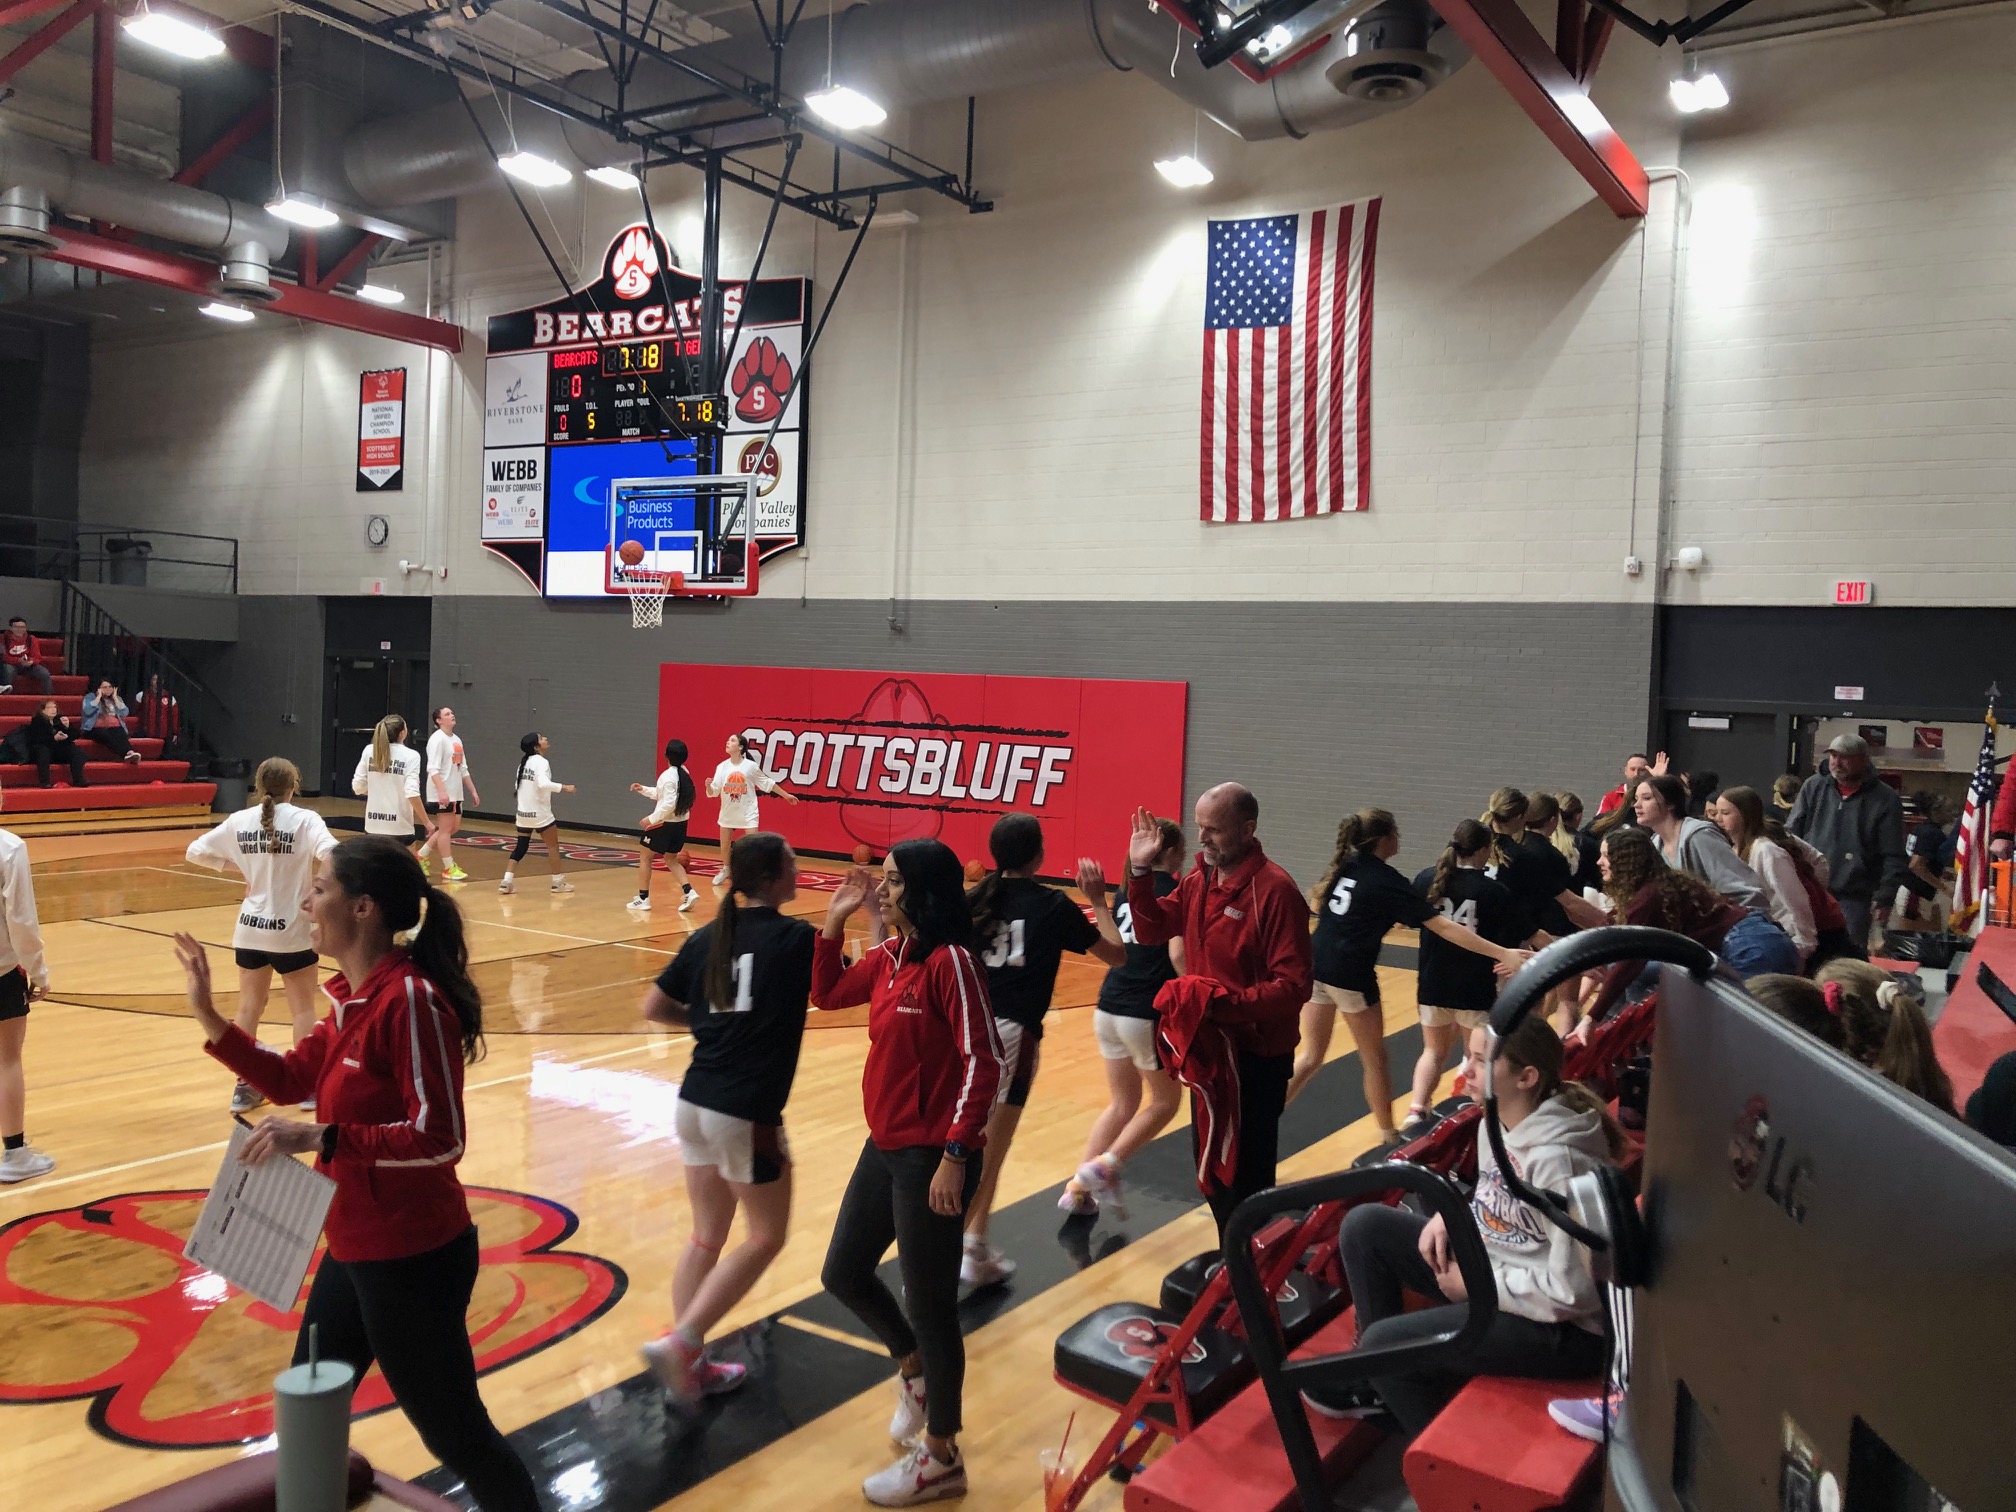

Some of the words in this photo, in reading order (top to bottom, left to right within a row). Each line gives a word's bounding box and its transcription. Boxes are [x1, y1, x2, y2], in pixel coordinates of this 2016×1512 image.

[553, 350, 598, 368] BEARCATS
[620, 344, 659, 369] 7:18
[614, 398, 634, 408] PLAYER
[754, 385, 766, 411] S
[487, 404, 544, 418] RIVERSTONE
[554, 404, 569, 412] FOULS
[587, 412, 596, 430] 5
[554, 432, 569, 440] SCORE
[622, 428, 640, 436] MATCH
[491, 458, 538, 482] WEBB
[745, 453, 775, 470] PC
[486, 484, 505, 493] FAMILY
[505, 484, 512, 493] OF
[512, 482, 542, 492] COMPANIES
[629, 499, 673, 514] Business
[760, 500, 796, 517] Valley
[627, 514, 674, 529] Products
[1836, 581, 1867, 603] EXIT
[740, 727, 1073, 806] SCOTTSBLUFF
[367, 811, 397, 822] BOWLIN
[1328, 876, 1357, 916] 5
[239, 912, 287, 931] ROBBINS
